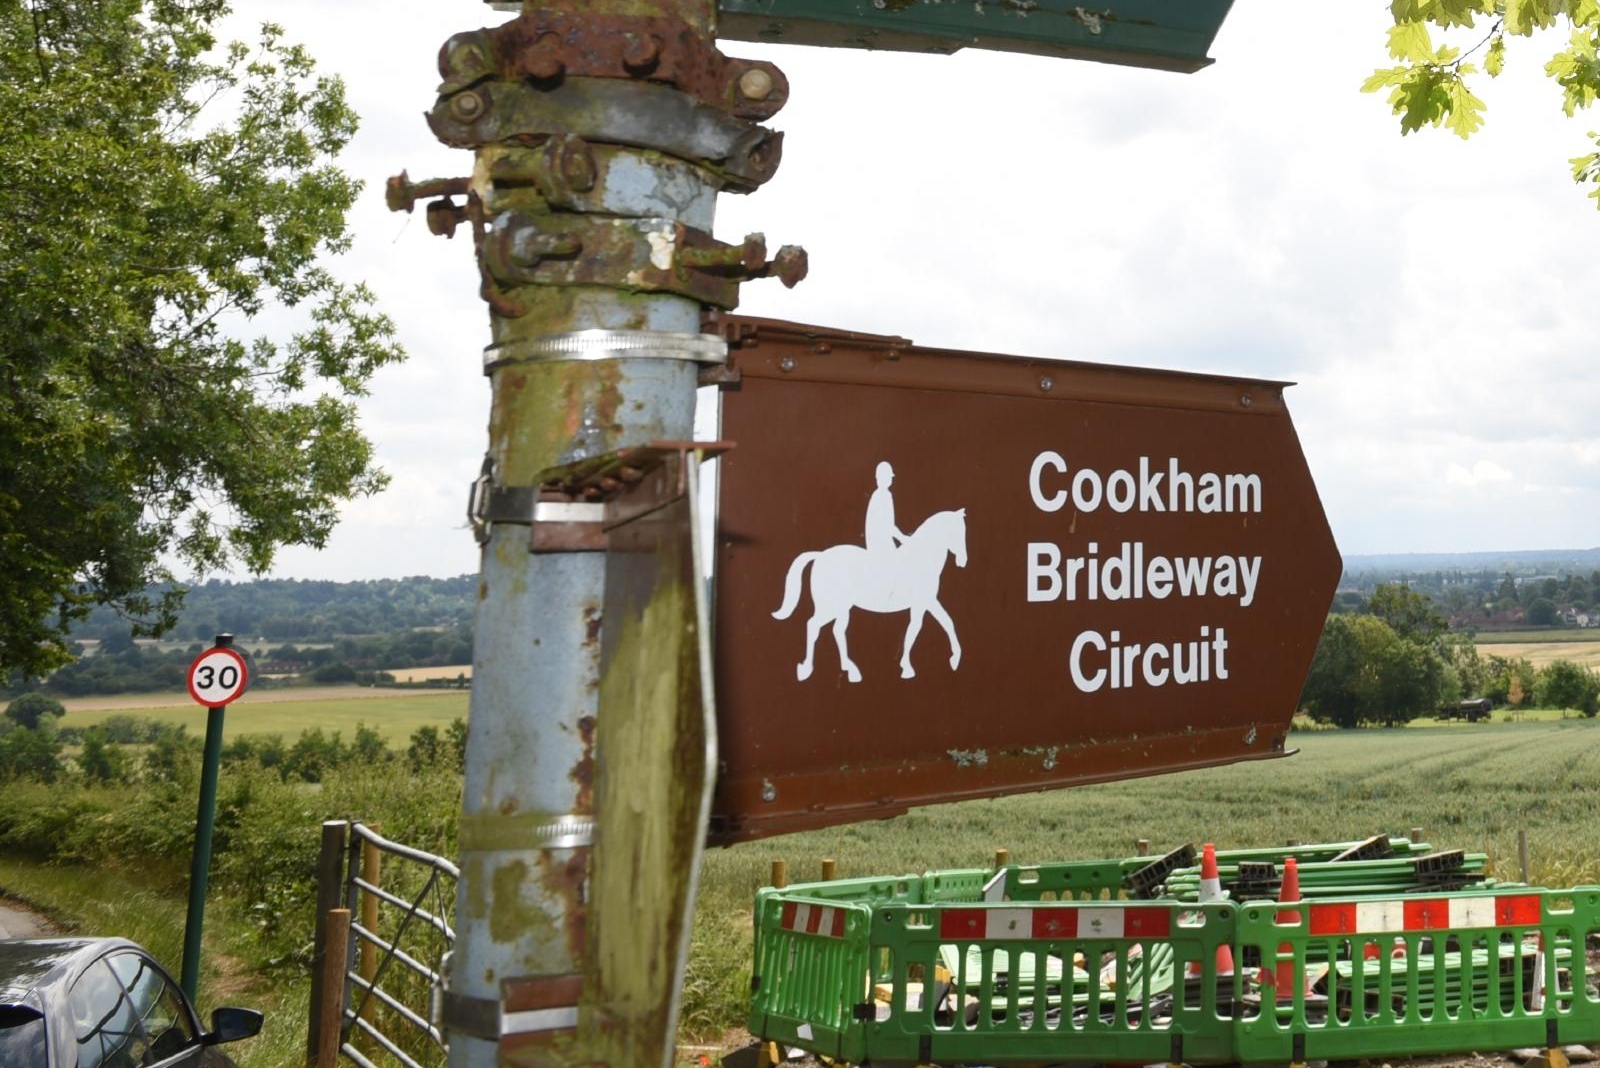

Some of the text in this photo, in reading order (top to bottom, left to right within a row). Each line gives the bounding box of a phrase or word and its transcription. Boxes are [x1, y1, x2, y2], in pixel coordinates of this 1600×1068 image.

[1028, 450, 1263, 514] Cookham
[1026, 541, 1263, 607] Bridleway
[196, 666, 239, 690] 30
[1068, 626, 1229, 693] Circuit
